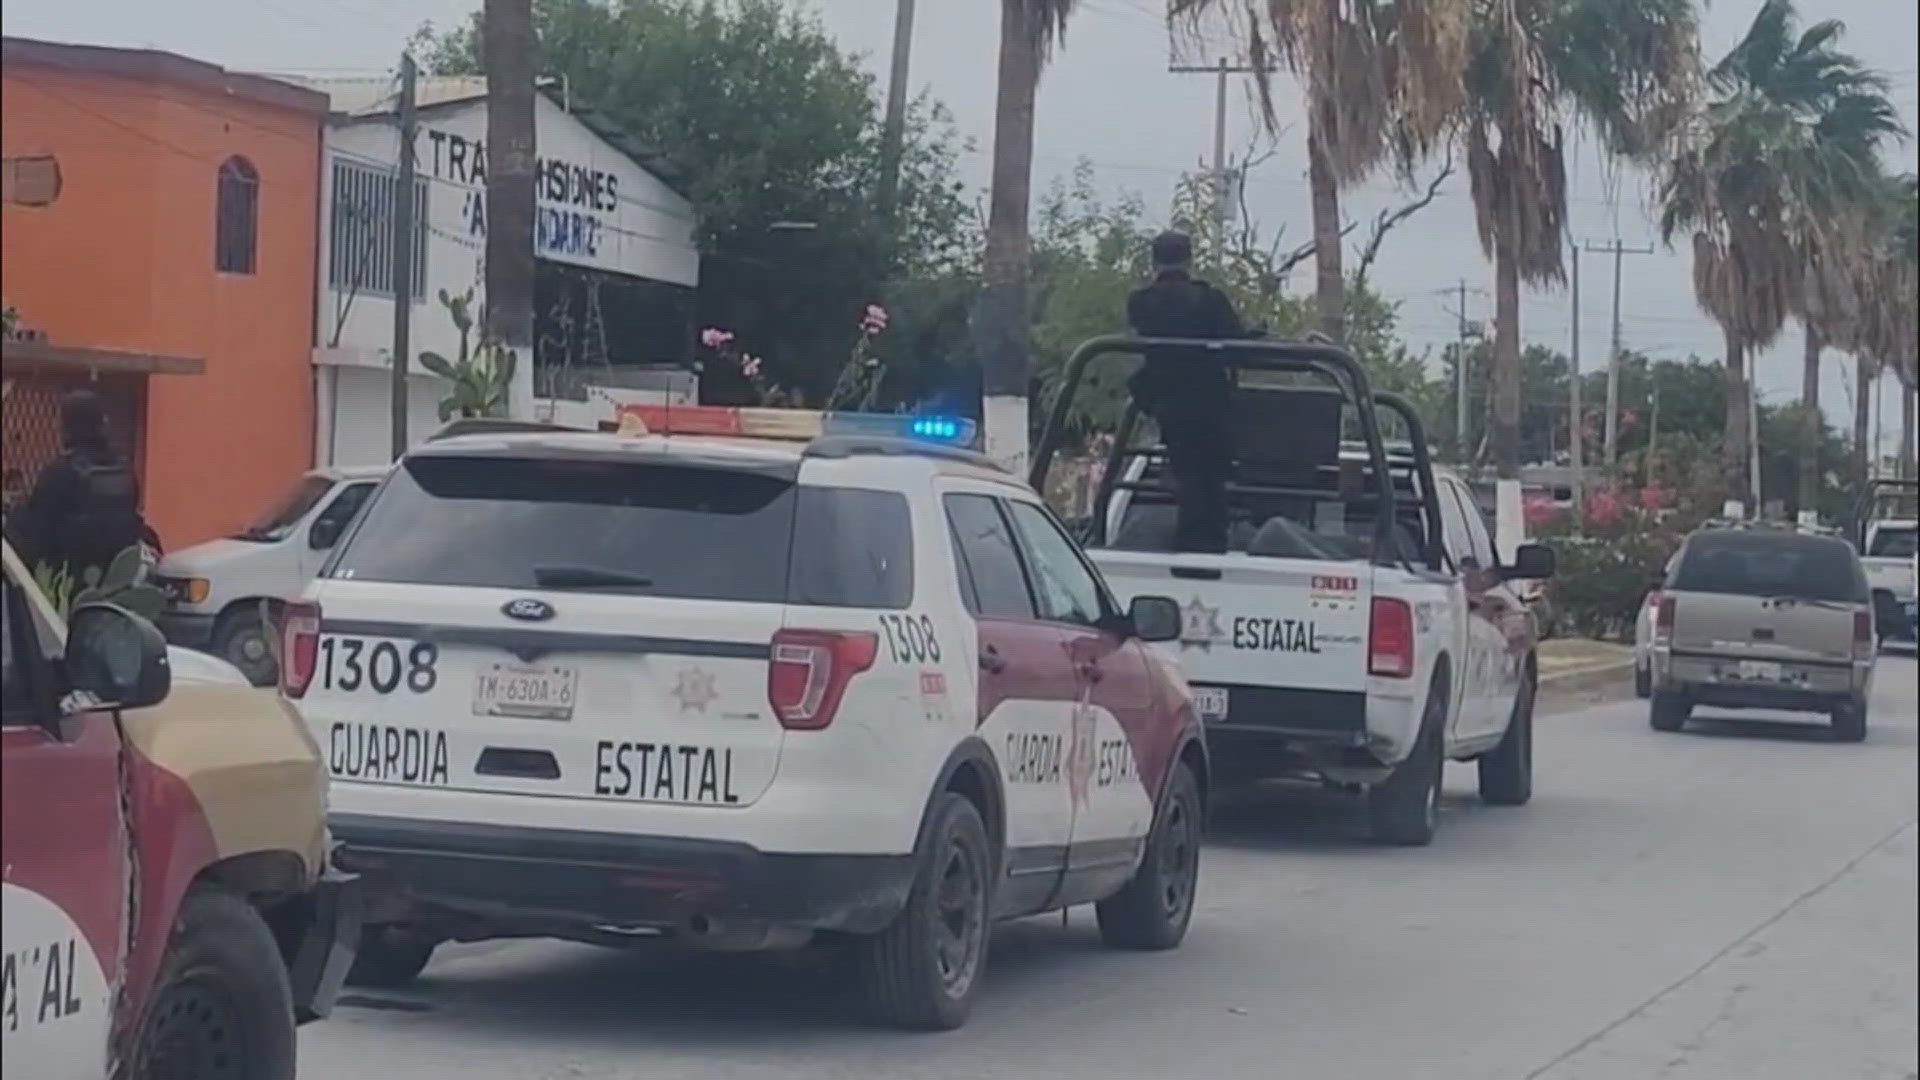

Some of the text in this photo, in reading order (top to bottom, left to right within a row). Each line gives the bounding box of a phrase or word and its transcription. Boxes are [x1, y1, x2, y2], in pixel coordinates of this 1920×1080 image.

[879, 614, 941, 663] 1308
[1233, 617, 1321, 653] ESTATAL
[321, 637, 439, 694] 1308
[330, 721, 738, 803] GUARDIA ESTATAL
[1007, 732, 1063, 783] GUARDIA
